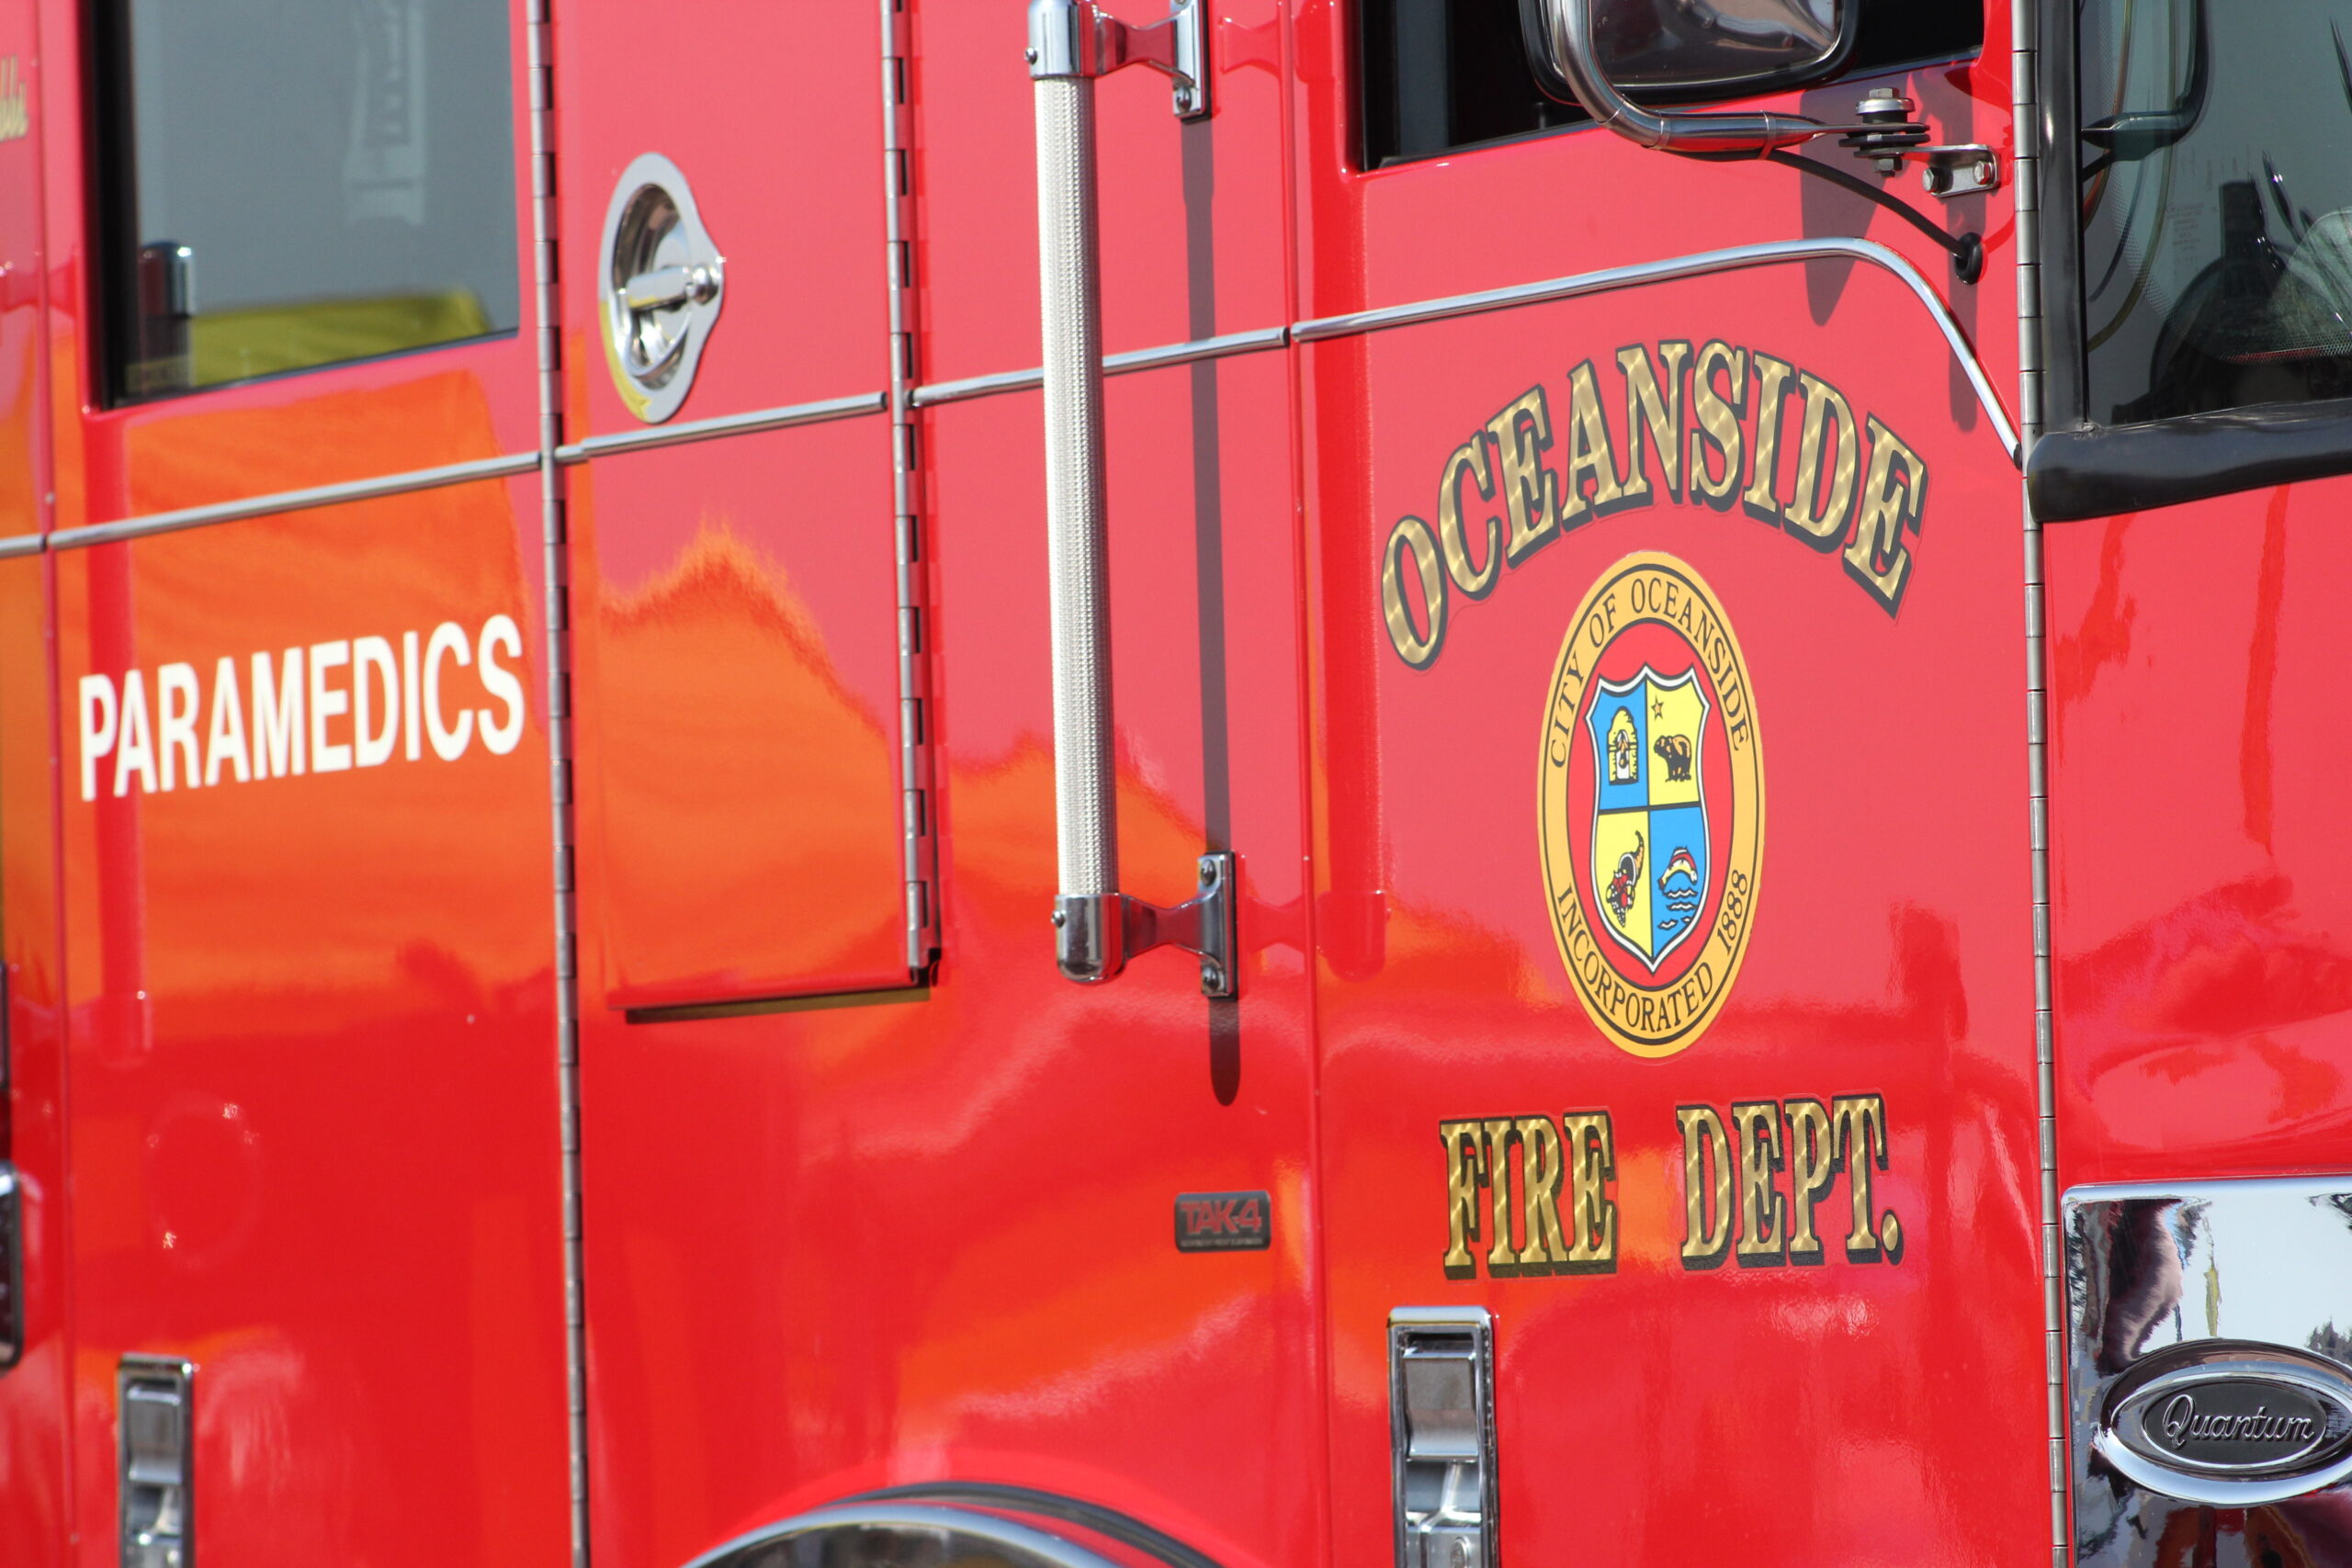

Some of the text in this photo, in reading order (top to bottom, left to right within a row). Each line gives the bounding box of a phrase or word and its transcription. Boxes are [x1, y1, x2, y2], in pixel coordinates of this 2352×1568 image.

[1382, 339, 1929, 670] OCEANSIDE
[79, 615, 525, 802] PARAMEDICS
[1550, 577, 1749, 768] CITY OF OCEANSIDE
[1557, 869, 1748, 1033] INCORPORATED 1888
[1440, 1093, 1905, 1280] FIRE DEPT.
[2163, 1393, 2316, 1450] Quantum
